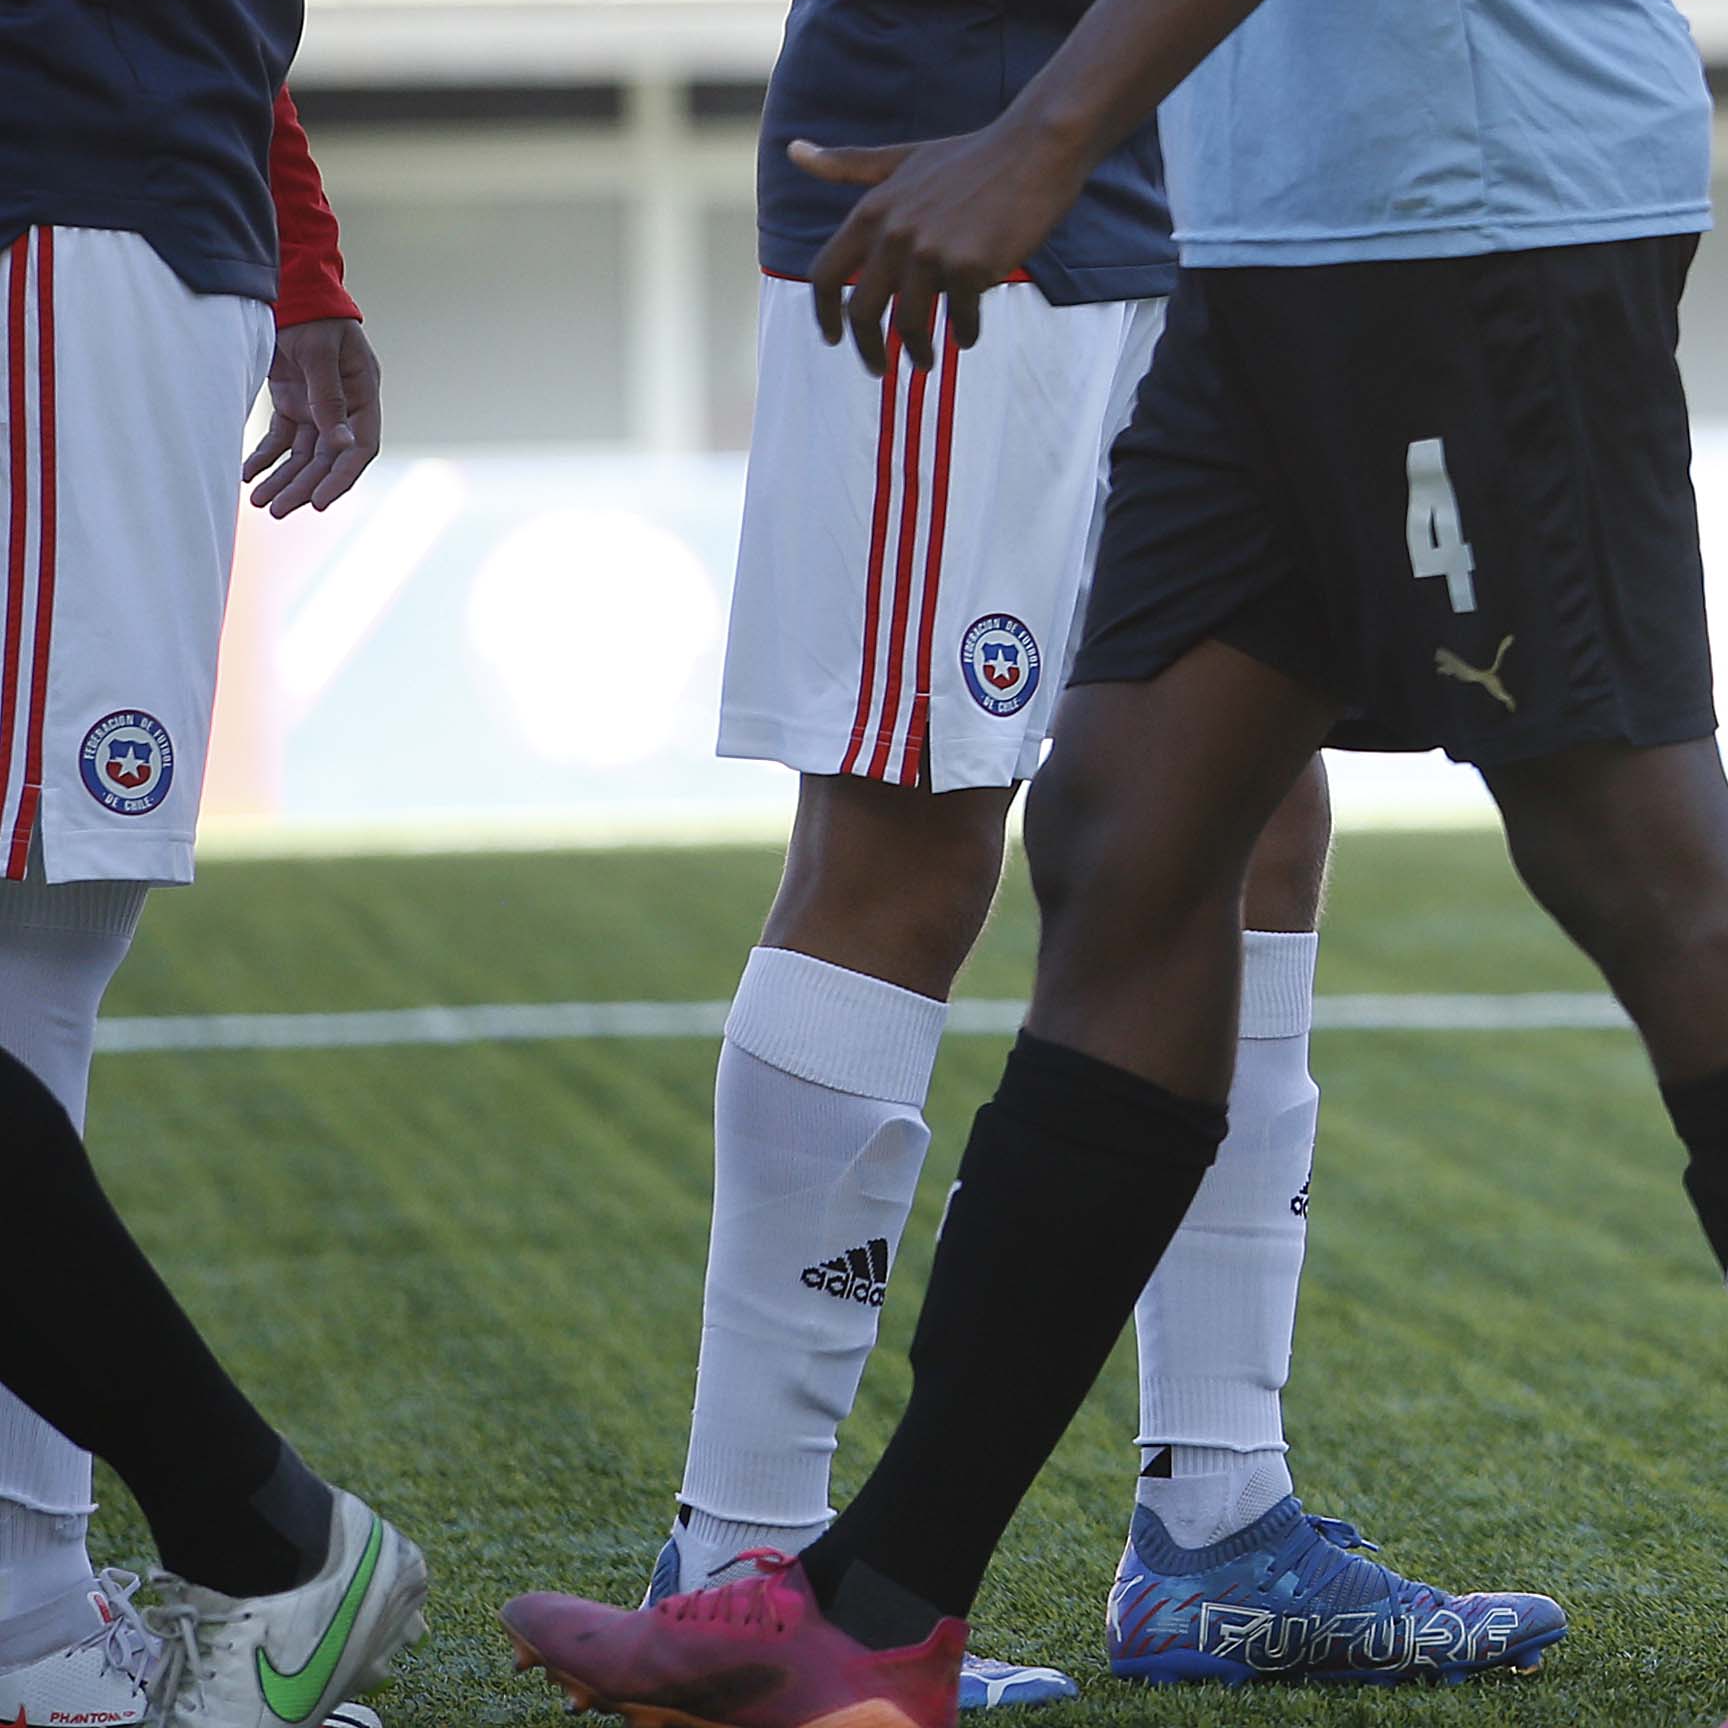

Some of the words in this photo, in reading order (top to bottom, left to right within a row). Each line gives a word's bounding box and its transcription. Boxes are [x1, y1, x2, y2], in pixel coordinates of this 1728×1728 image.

[1406, 438, 1476, 613] 4
[140, 717, 155, 731] DE
[104, 795, 119, 809] DE
[800, 1267, 886, 1307] adida
[1199, 1600, 1519, 1672] FUTURE
[49, 1711, 122, 1724] PHANTOM
